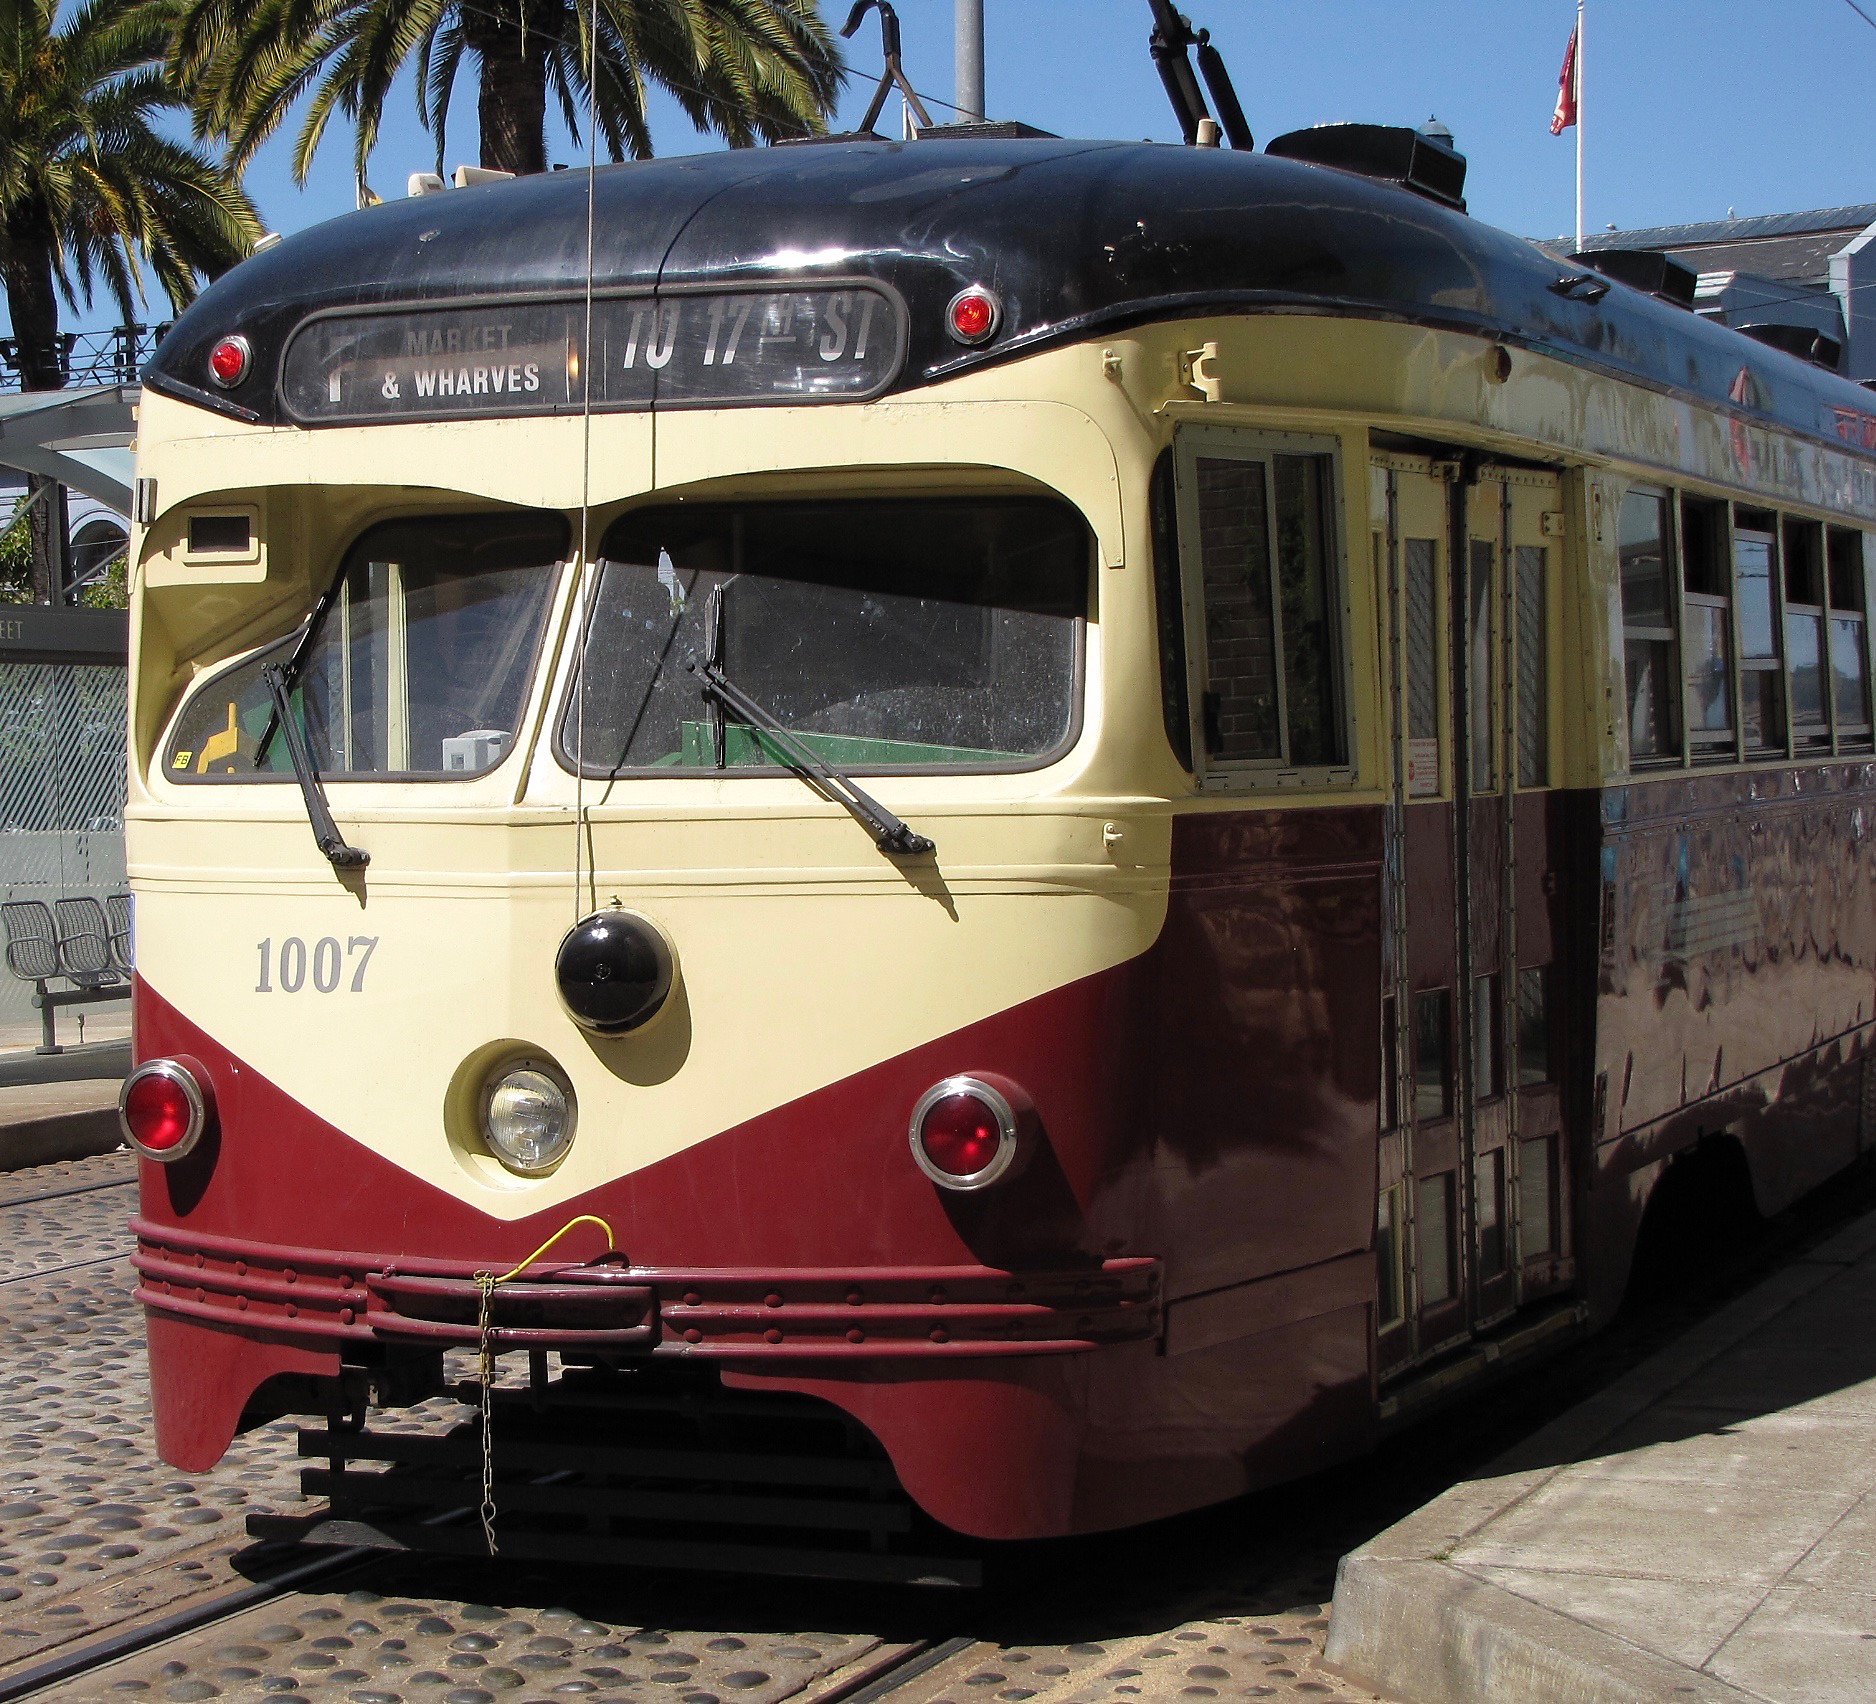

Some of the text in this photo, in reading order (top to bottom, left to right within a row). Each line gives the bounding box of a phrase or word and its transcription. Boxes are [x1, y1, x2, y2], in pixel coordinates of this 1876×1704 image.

[407, 324, 513, 356] MARKET
[623, 298, 681, 369] TO
[819, 291, 881, 361] ST
[381, 362, 540, 399] & WHARVES
[175, 755, 189, 765] FB
[255, 936, 379, 993] 1007
